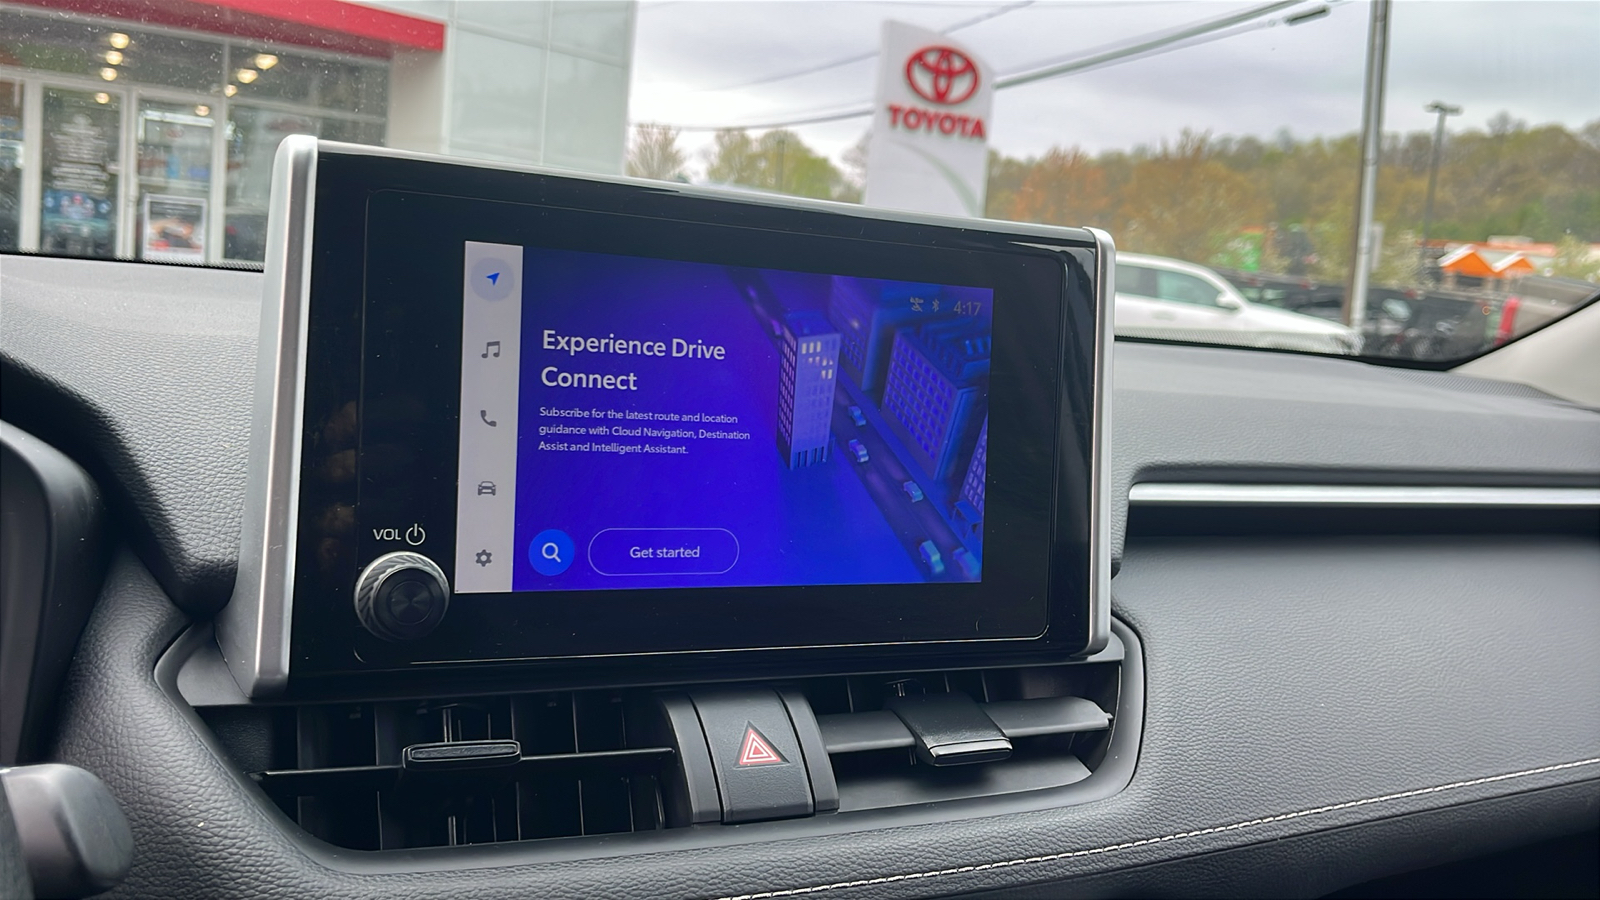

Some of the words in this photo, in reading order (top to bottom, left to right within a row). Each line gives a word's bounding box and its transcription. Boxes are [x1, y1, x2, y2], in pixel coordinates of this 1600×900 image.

[888, 104, 986, 141] TOYOTA
[953, 300, 982, 316] 4:17
[542, 329, 667, 356] Experience
[671, 338, 726, 360] Drive
[540, 366, 638, 391] Connect
[539, 406, 590, 418] Subscribe
[591, 408, 606, 419] for
[607, 409, 624, 420] the
[625, 410, 653, 421] latest
[654, 412, 680, 422] route
[681, 413, 700, 422] and
[701, 413, 739, 424] location
[538, 424, 587, 436] guidance
[588, 426, 610, 436] with
[611, 426, 642, 437] Cloud
[643, 428, 697, 440] Navigation,
[698, 429, 751, 440] Destination
[538, 441, 569, 451] Assist
[569, 442, 590, 452] and
[591, 442, 642, 455] Intelligent
[643, 444, 689, 455] Assistant.
[372, 528, 402, 541] VOL
[629, 546, 654, 559] Get
[656, 545, 701, 558] started
